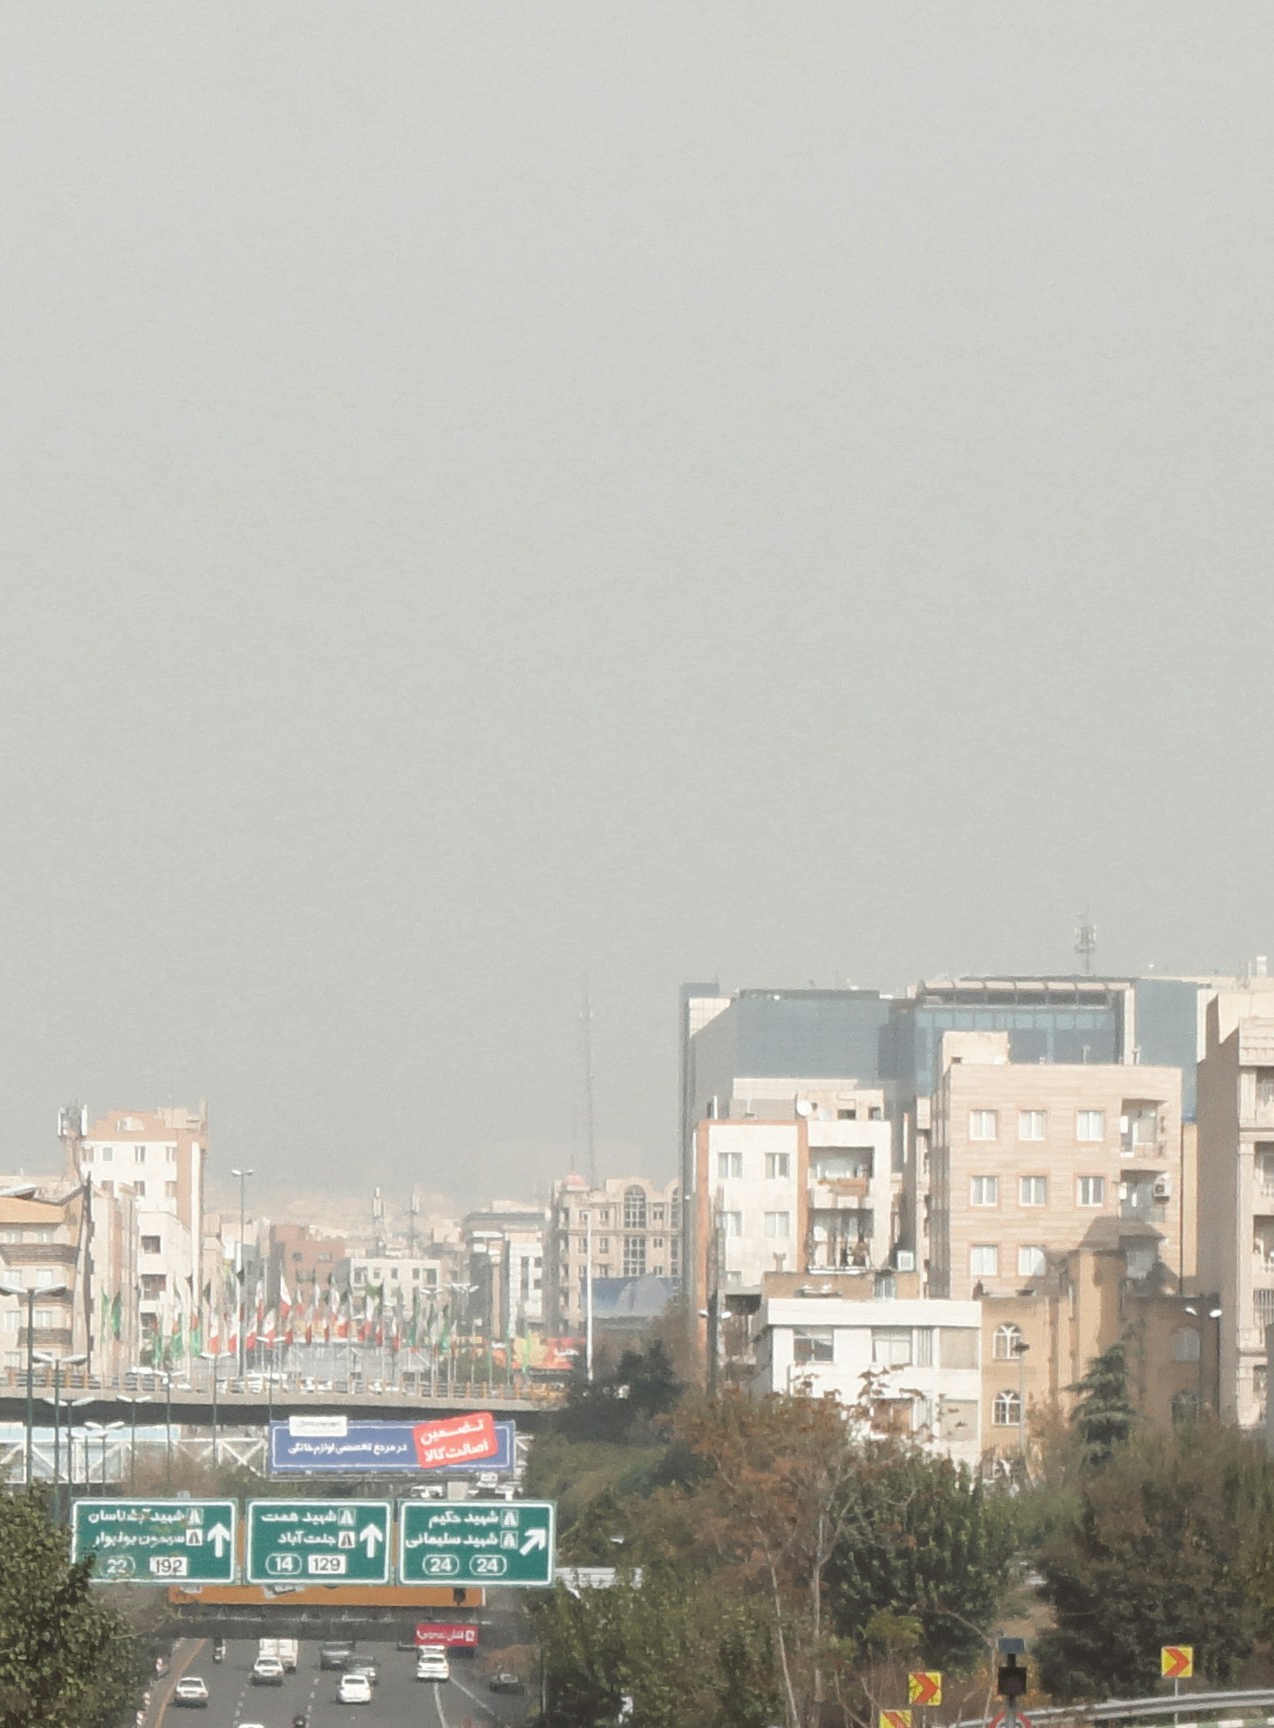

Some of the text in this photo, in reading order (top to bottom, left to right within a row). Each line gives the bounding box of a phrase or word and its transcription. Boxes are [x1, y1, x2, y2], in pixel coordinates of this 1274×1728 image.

[420, 1419, 484, 1445] تضمین
[425, 1437, 489, 1462] اصالت کالا
[150, 1508, 185, 1523] شهید
[261, 1510, 336, 1525] شهید همت
[428, 1510, 499, 1528] شهید حکیم
[277, 1530, 336, 1546] جنت آباد
[405, 1532, 499, 1548] شهید سلیمانی
[106, 1559, 127, 1574] 22
[156, 1558, 183, 1573] 192
[275, 1556, 294, 1572] 14
[313, 1557, 341, 1571] 129
[430, 1558, 452, 1572] 24
[476, 1558, 499, 1572] 24
